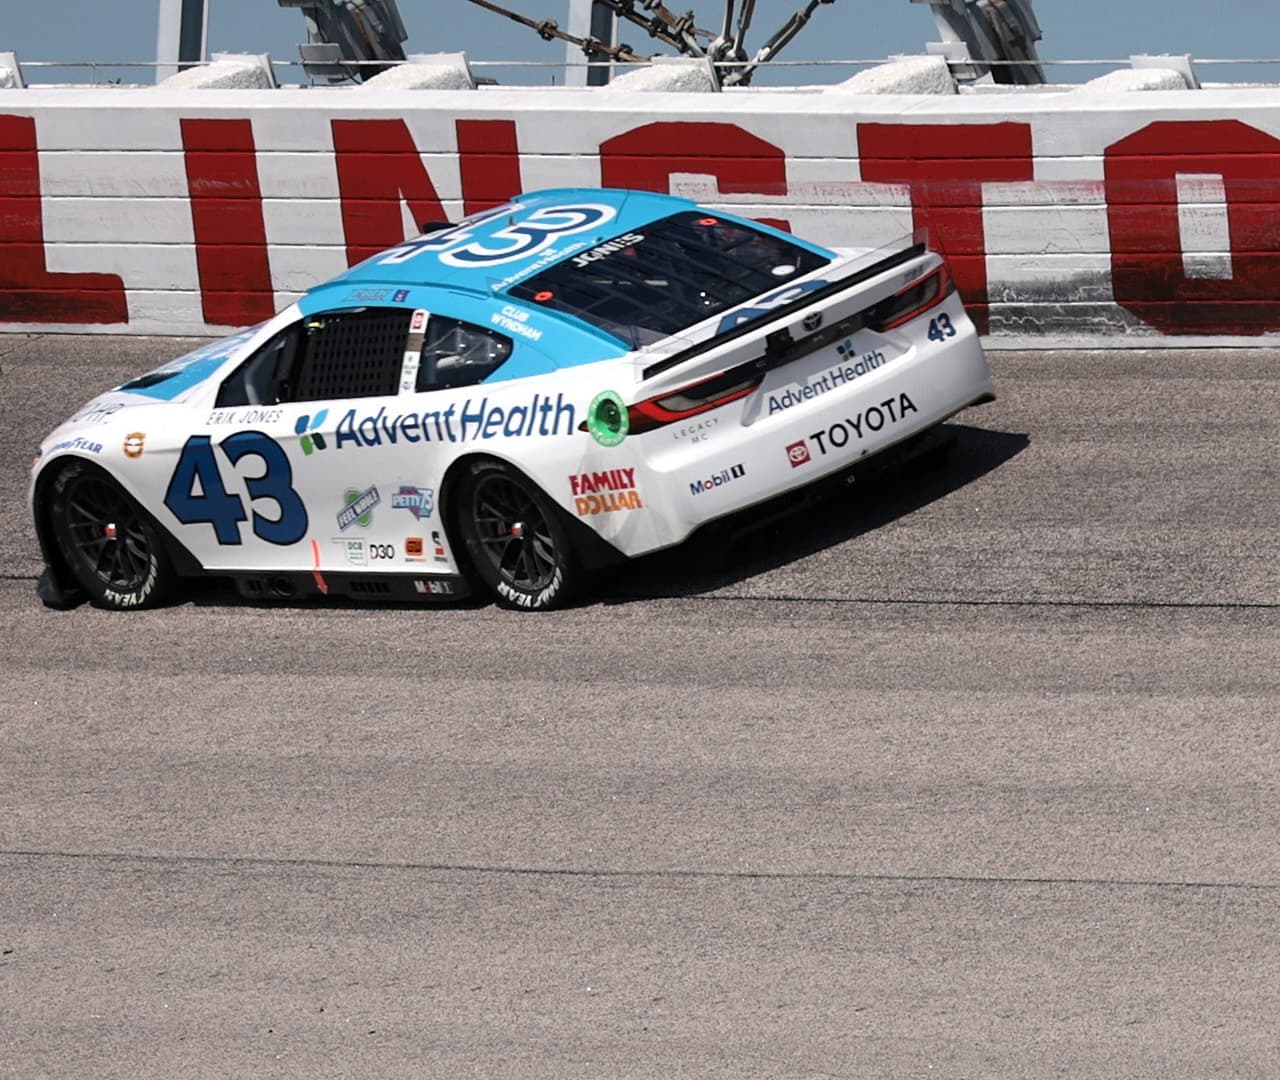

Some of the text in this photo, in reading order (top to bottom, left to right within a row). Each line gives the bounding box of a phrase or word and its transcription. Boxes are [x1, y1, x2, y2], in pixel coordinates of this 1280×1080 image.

[928, 312, 957, 341] 43
[769, 349, 887, 415] AdventHealth
[206, 409, 284, 425] ERIK JONES
[336, 393, 575, 449] AdventHealth
[673, 416, 719, 440] LEGACY
[810, 393, 918, 455] TOYOTA
[164, 430, 308, 545] 43
[569, 467, 636, 496] FAMILY
[690, 464, 745, 496] Mobil 1
[575, 490, 643, 516] DOLLAR
[497, 567, 562, 607] GOODYEAR
